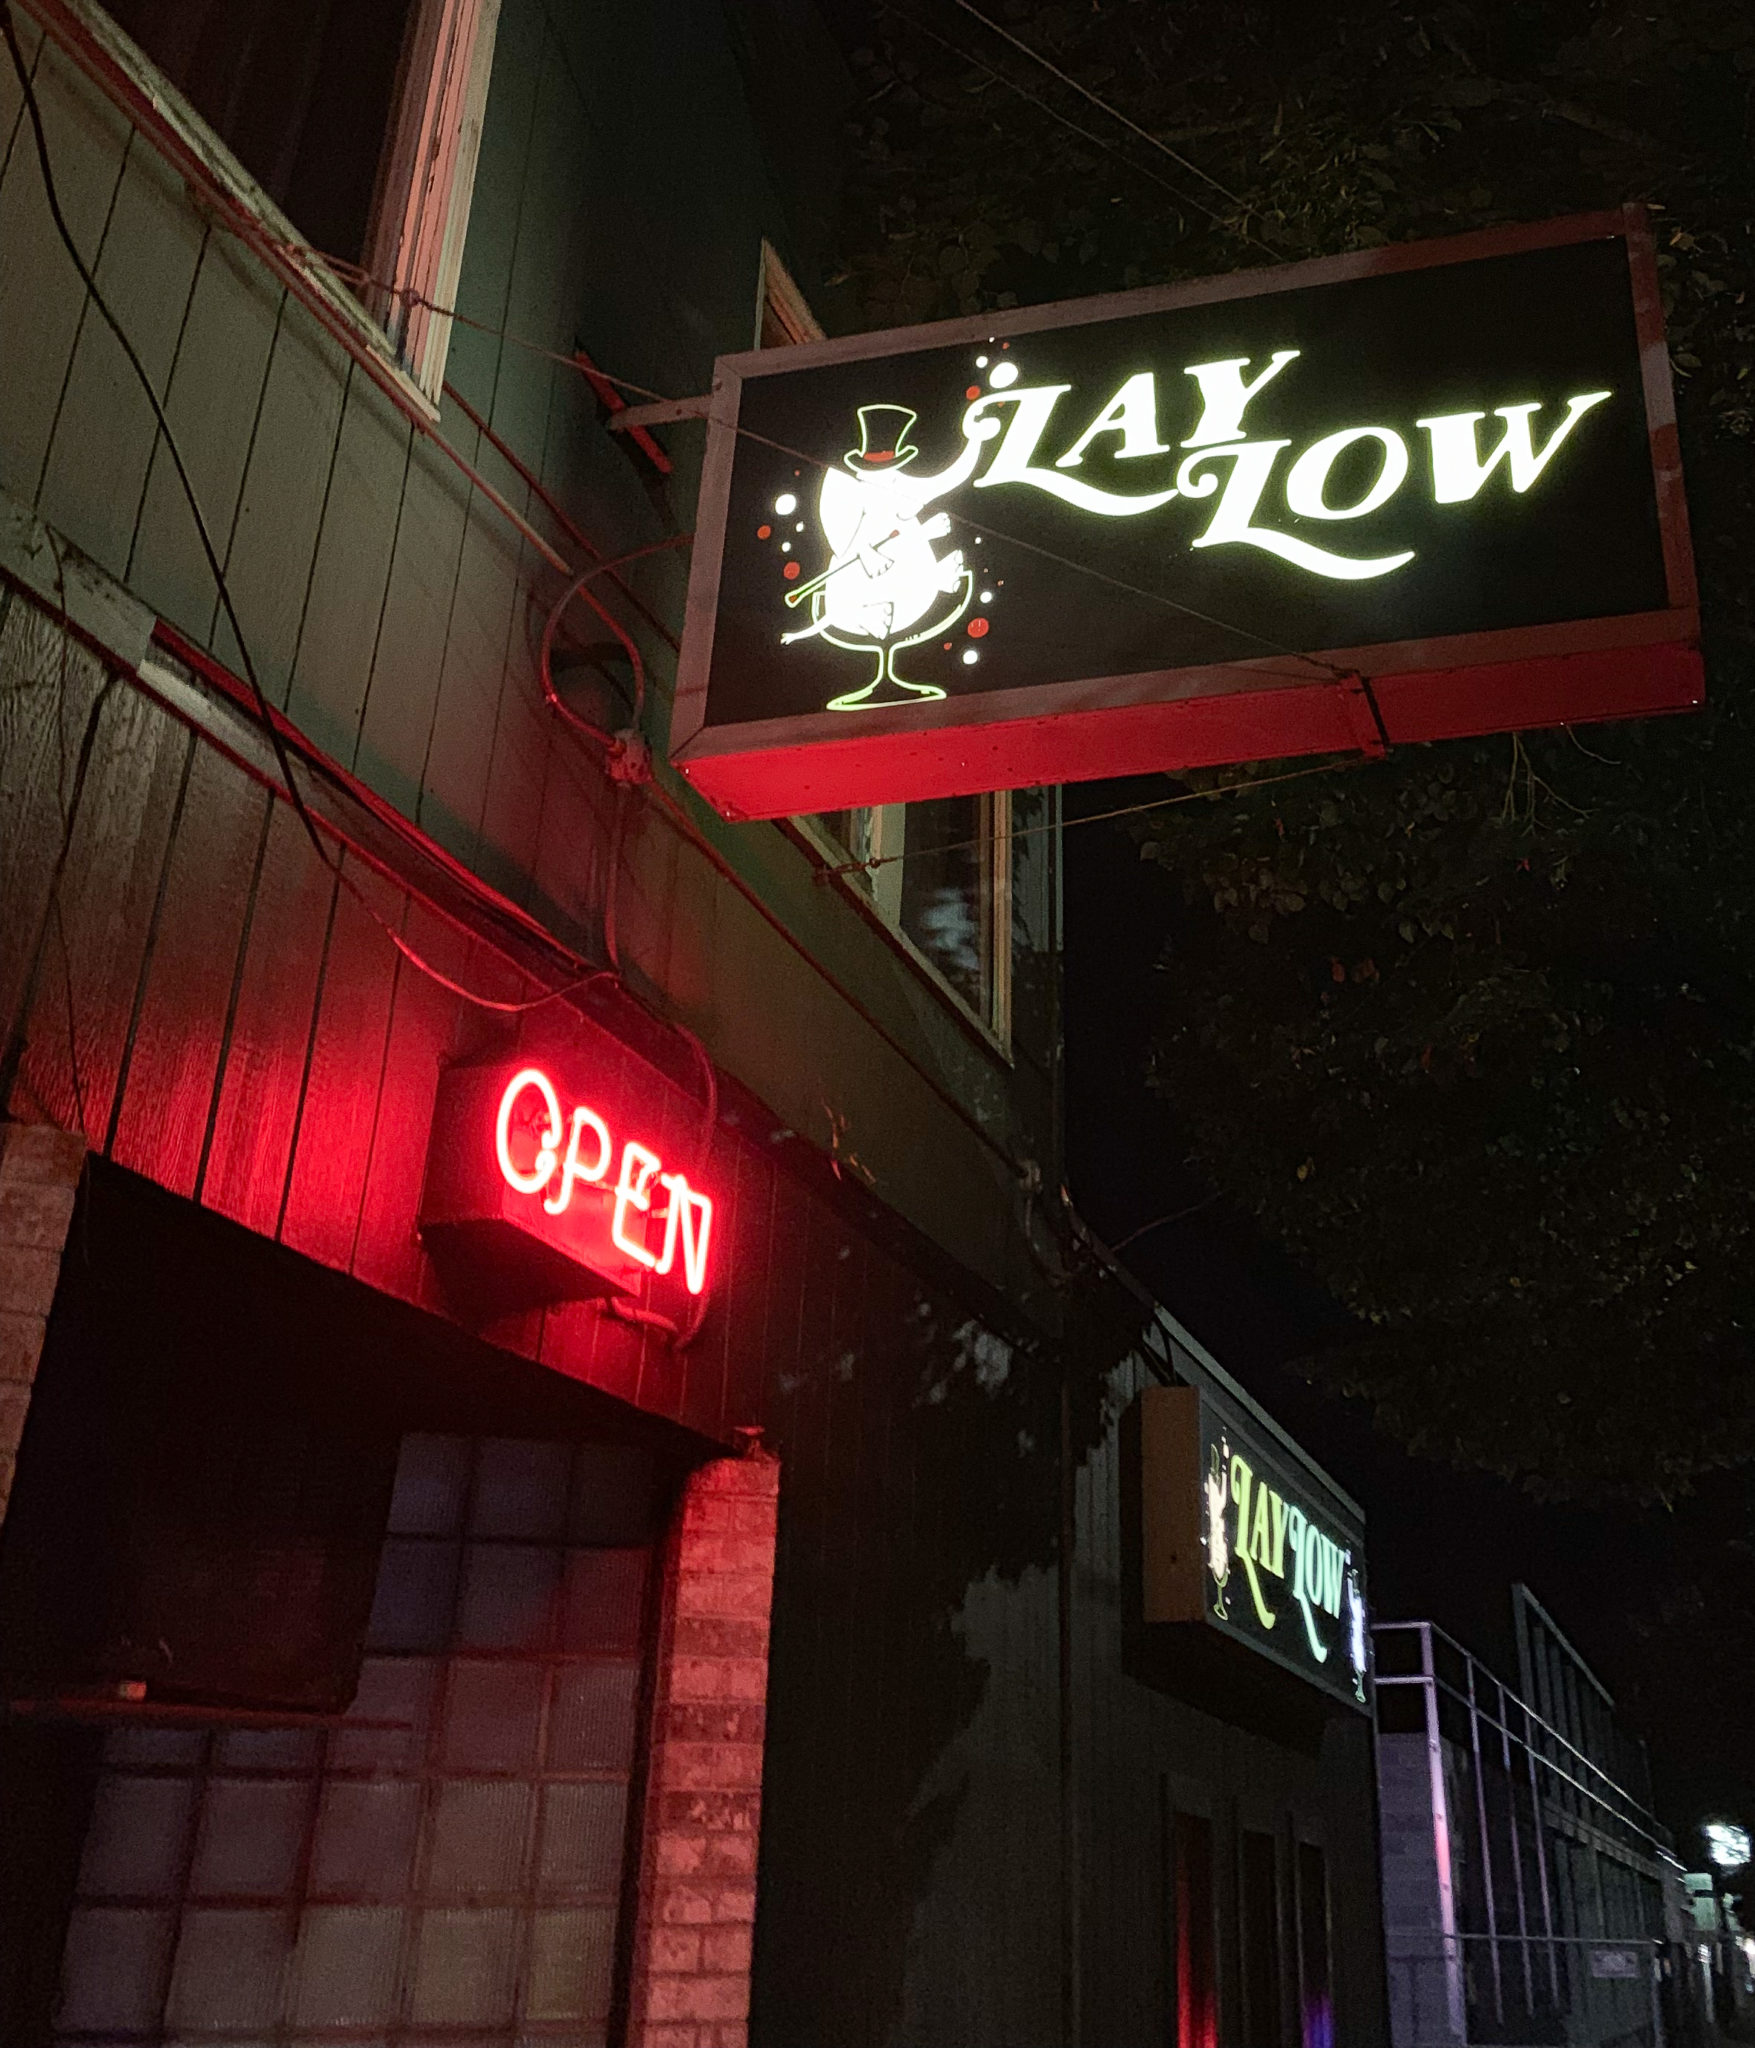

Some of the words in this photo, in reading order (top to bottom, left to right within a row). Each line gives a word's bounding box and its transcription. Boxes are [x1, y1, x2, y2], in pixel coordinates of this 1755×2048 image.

[962, 350, 1301, 516] LAY
[1177, 390, 1612, 580] LOW
[496, 1069, 712, 1294] OPEN
[1231, 1455, 1290, 1629] LAY
[1286, 1506, 1345, 1663] LOW
